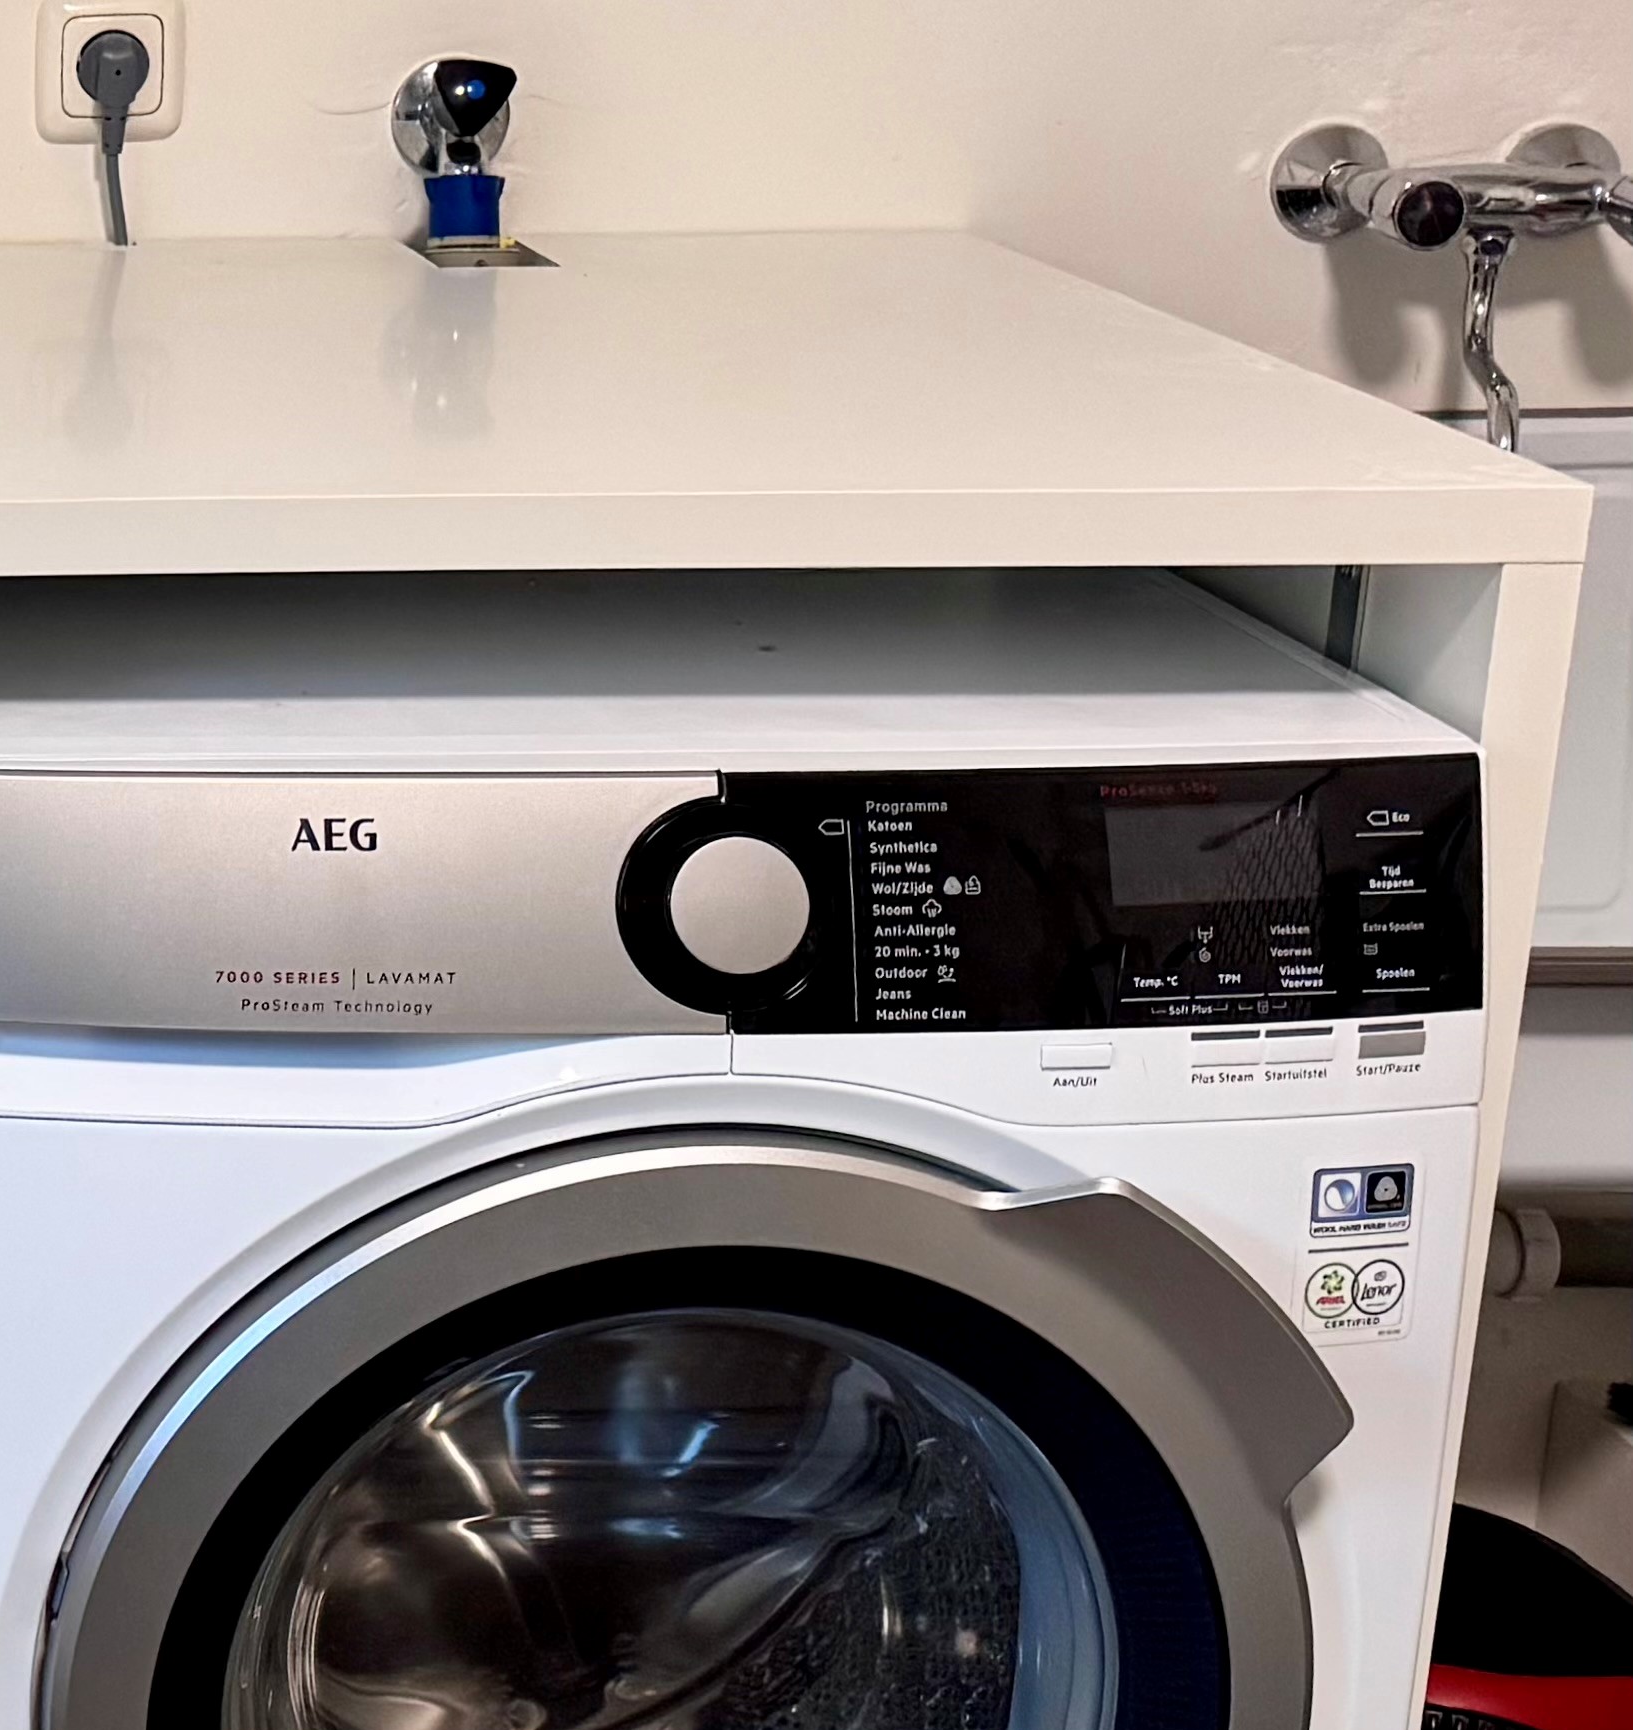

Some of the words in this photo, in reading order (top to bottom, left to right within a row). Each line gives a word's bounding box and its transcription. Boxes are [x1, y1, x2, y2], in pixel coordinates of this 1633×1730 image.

[866, 800, 948, 816] Programma
[868, 820, 913, 832] Katoen
[291, 818, 377, 852] AEG
[871, 861, 902, 877] Fijne
[905, 861, 931, 874] Was
[1381, 864, 1401, 878] Tijd
[871, 881, 933, 896] Wol/Zijde
[872, 904, 913, 916] Stoom
[874, 923, 956, 939] Anti-Allergie
[1363, 922, 1387, 932] Extra
[874, 945, 891, 957] 20
[933, 944, 941, 957] 3
[944, 944, 960, 959] kg
[1270, 946, 1313, 957] Voorwas
[214, 971, 264, 984] 7000
[273, 971, 340, 984] SERIES
[367, 972, 457, 984] LAVAMAT
[875, 966, 928, 979] Outdoor
[1218, 974, 1241, 984] TPM
[1376, 967, 1415, 980] Spoelen
[1281, 978, 1324, 988] Voorwas
[875, 988, 912, 1000] Jeans
[241, 998, 324, 1012] ProSteam
[335, 999, 433, 1016] Technology
[1191, 1004, 1213, 1015] Plus
[876, 1008, 928, 1021] Machine
[931, 1007, 966, 1020] Clean
[1191, 1072, 1215, 1084] Plus
[1219, 1072, 1254, 1084] Steam
[1264, 1067, 1328, 1082] Startuitstel
[1053, 1077, 1098, 1088] Aan/Uit
[1360, 1283, 1397, 1301] Lenor
[1324, 1317, 1380, 1329] CERTIFIED
